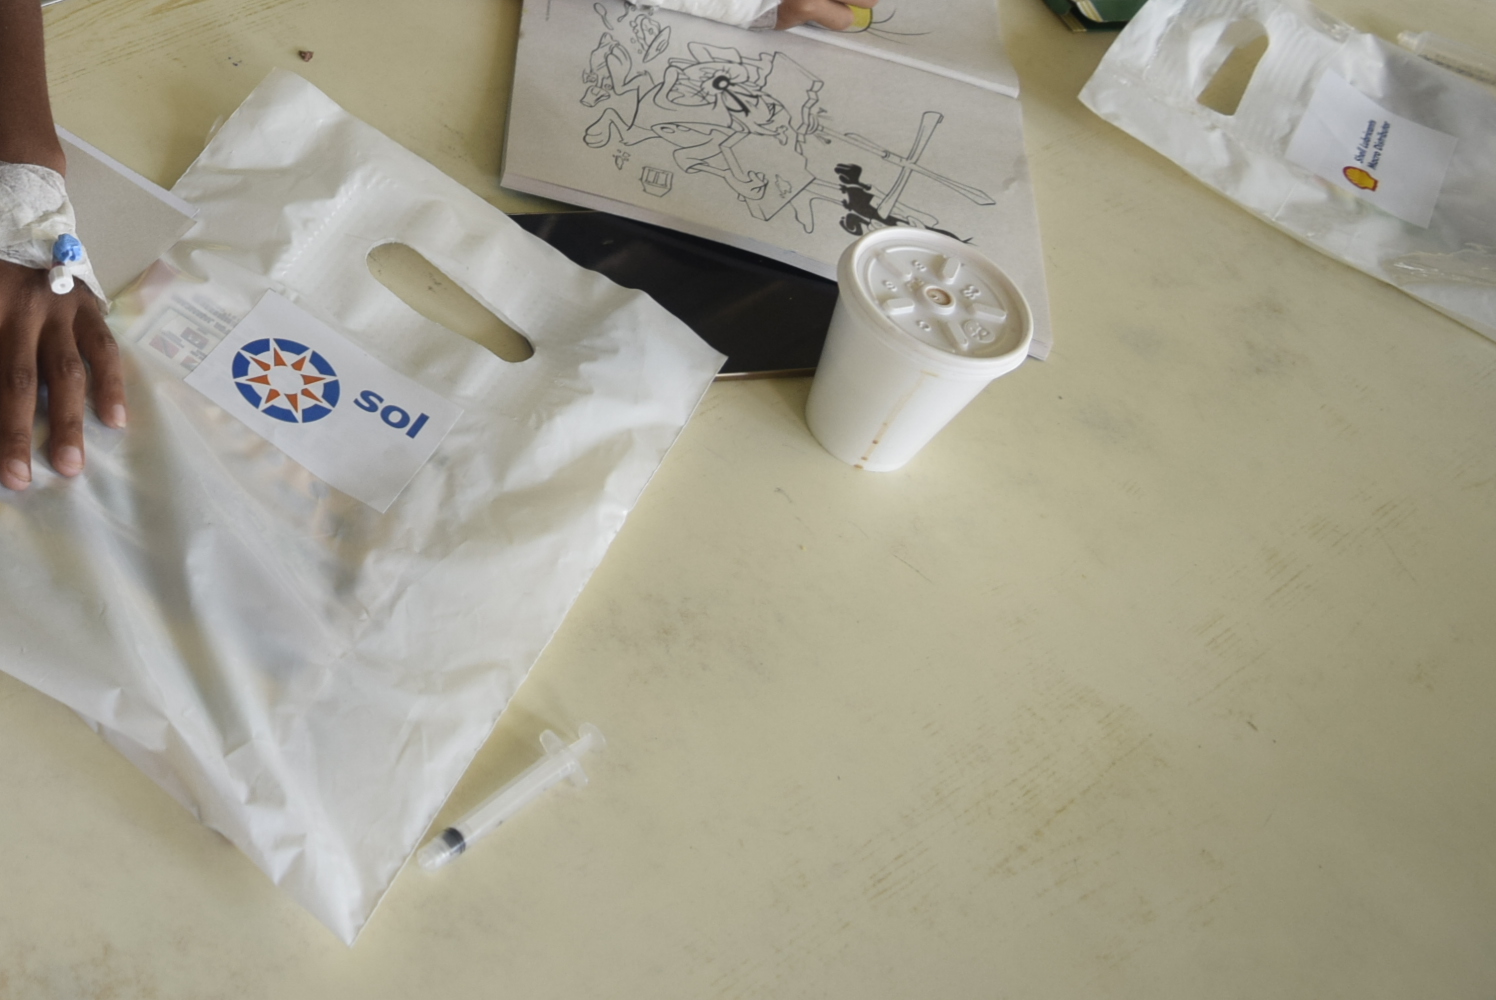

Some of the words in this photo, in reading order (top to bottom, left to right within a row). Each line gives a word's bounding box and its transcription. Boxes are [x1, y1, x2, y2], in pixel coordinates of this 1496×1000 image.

[1358, 119, 1376, 148] Lubricants
[1372, 120, 1390, 150] Distributor
[1353, 146, 1366, 163] Shell
[1366, 150, 1380, 169] Macro
[353, 389, 430, 439] sol
